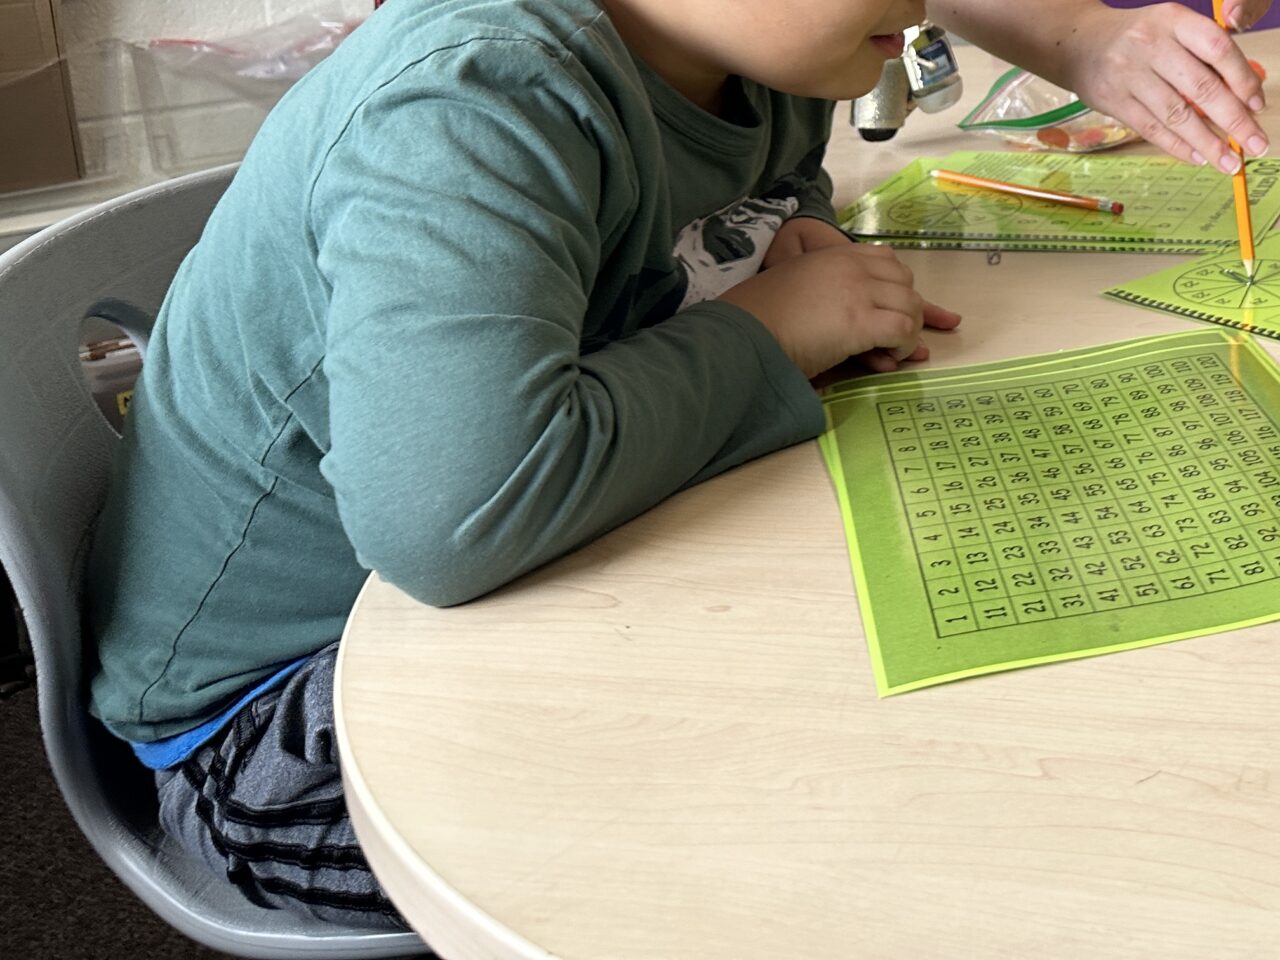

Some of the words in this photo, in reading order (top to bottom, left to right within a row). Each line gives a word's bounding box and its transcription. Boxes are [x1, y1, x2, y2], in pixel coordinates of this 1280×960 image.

[1033, 388, 1054, 399] 60
[886, 405, 906, 416] 10
[915, 402, 936, 413] 20
[1042, 406, 1064, 418] 59
[922, 422, 943, 432] 19
[1051, 423, 1074, 436] 58
[928, 440, 950, 451] 18
[1061, 444, 1084, 454] 57
[935, 461, 957, 471] 17
[1072, 462, 1095, 476] 56
[942, 480, 964, 492] 16
[1082, 483, 1107, 498] 55
[949, 503, 972, 516] 15
[1094, 506, 1119, 521] 54
[957, 525, 981, 539] 14
[1107, 530, 1132, 545] 53
[965, 551, 990, 565] 13
[1123, 555, 1146, 571] 52
[974, 578, 997, 593] 12
[1136, 582, 1159, 597] 51
[983, 606, 1008, 620] 11
